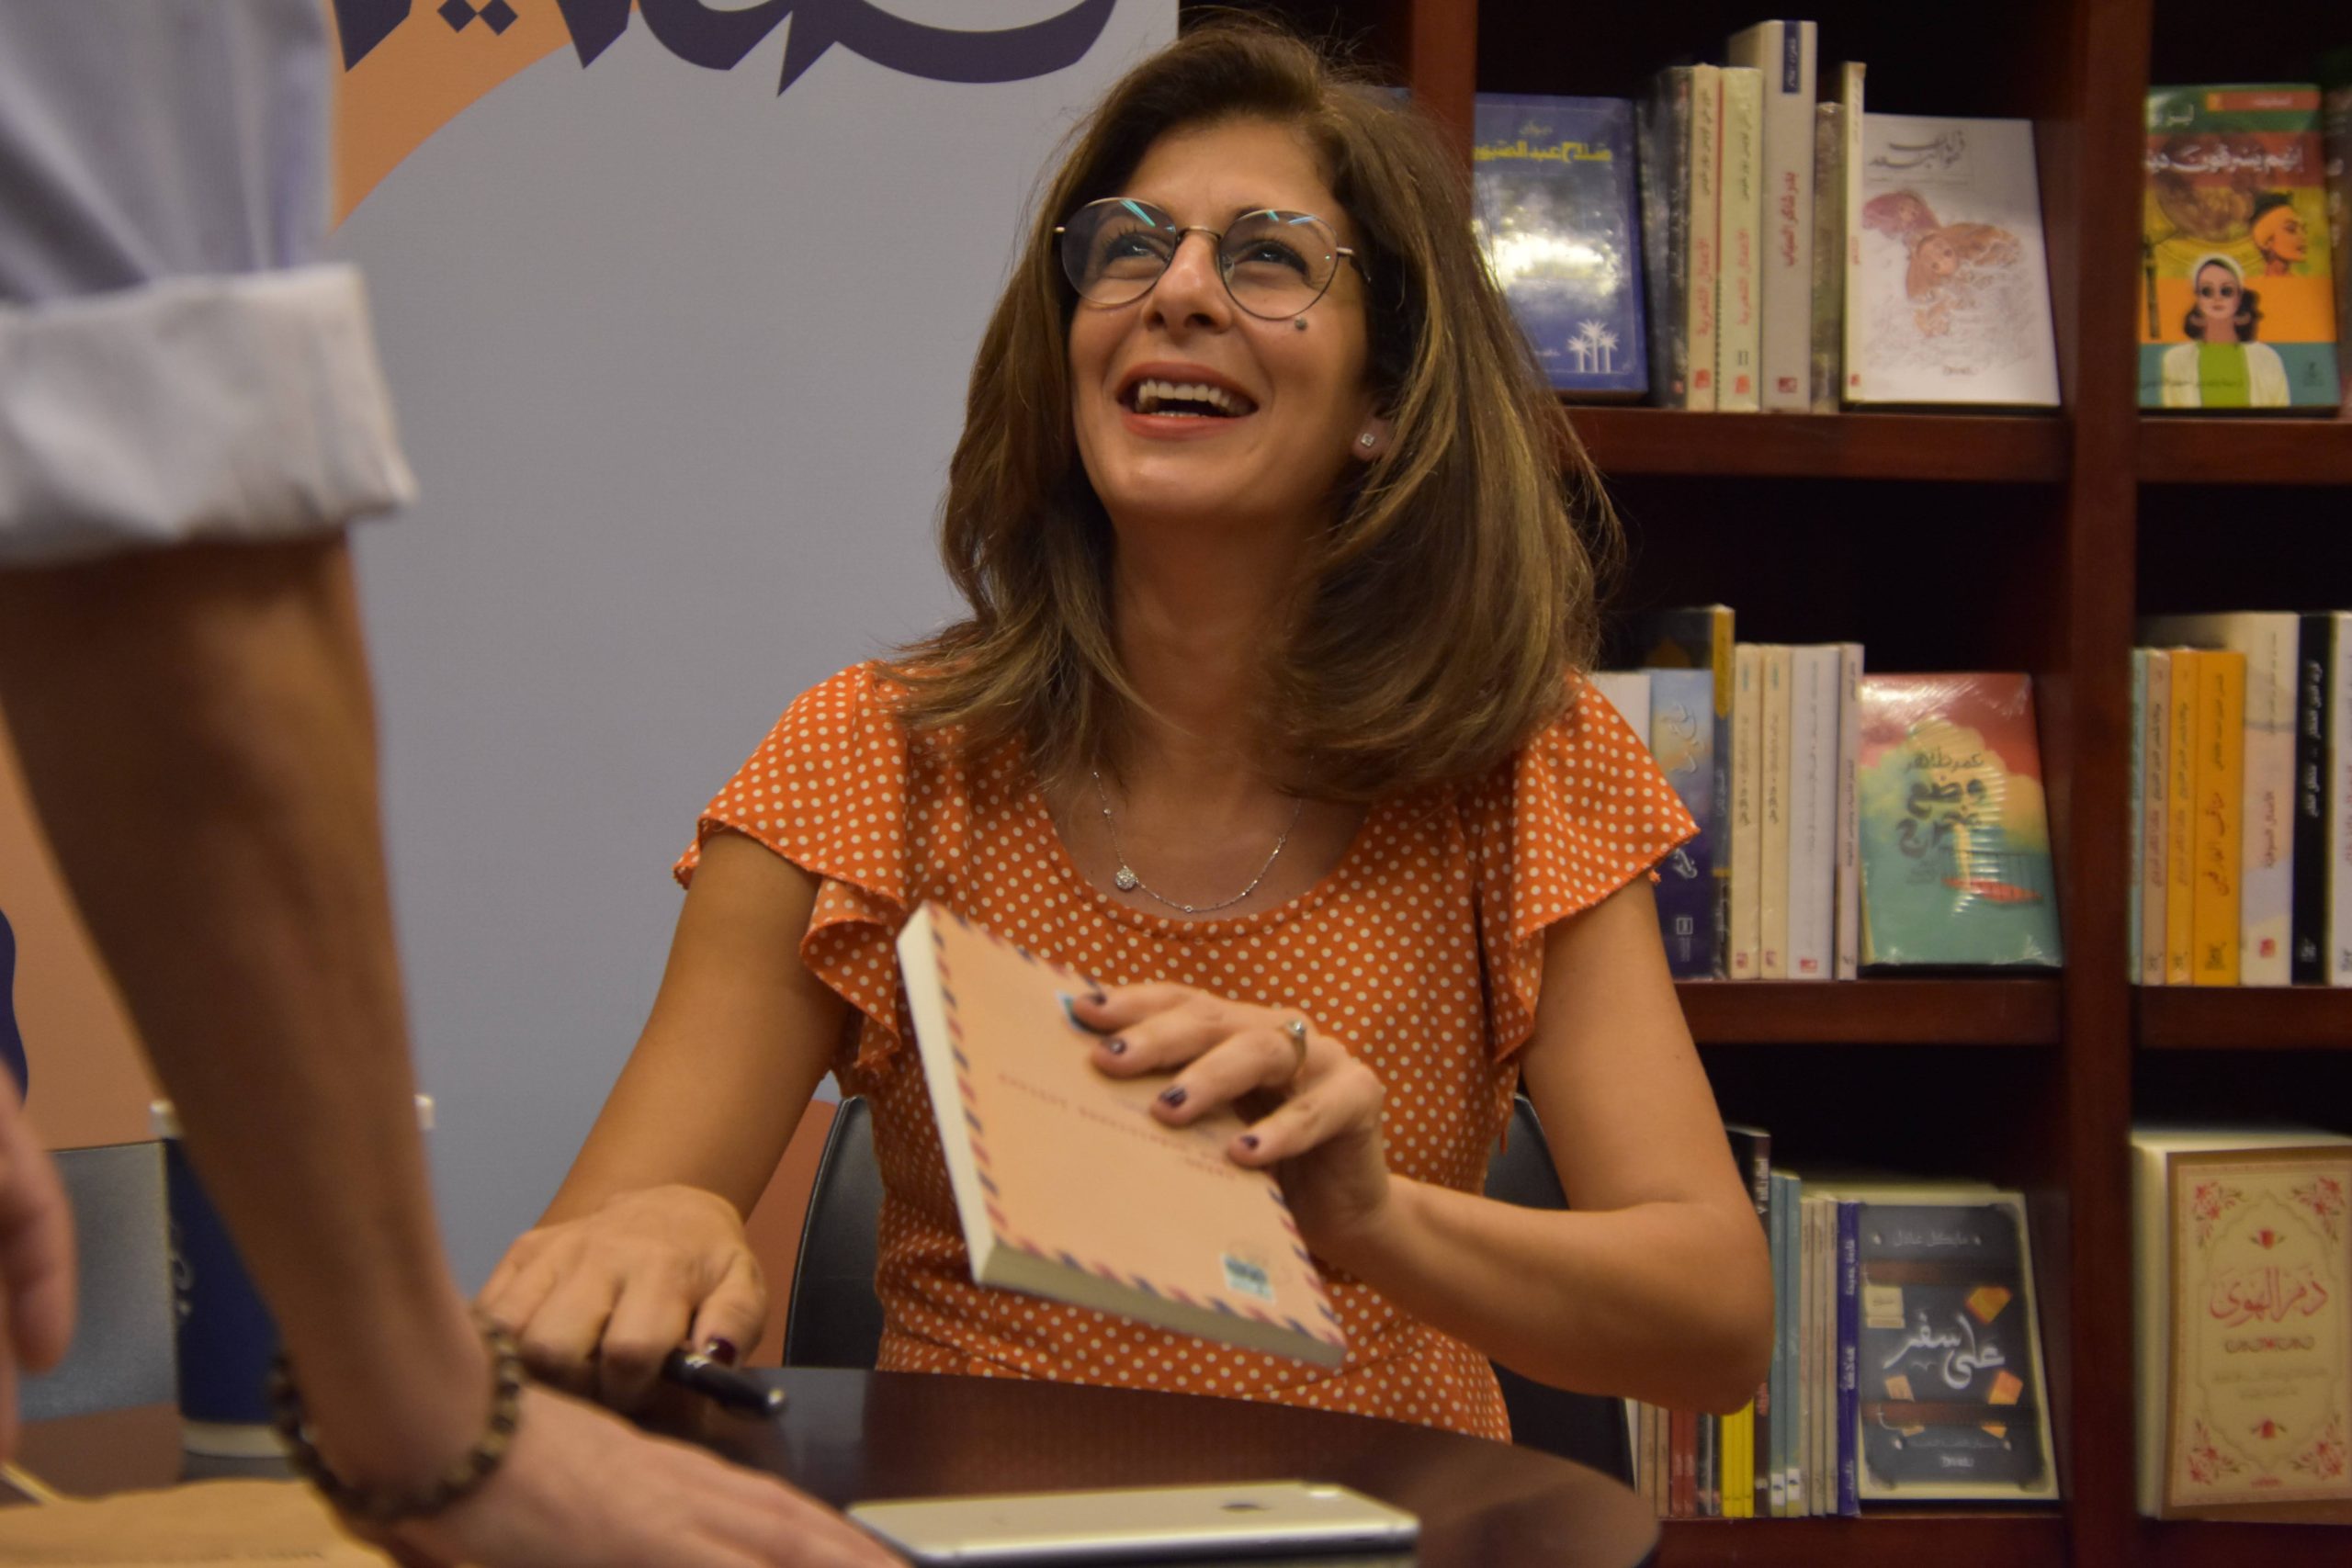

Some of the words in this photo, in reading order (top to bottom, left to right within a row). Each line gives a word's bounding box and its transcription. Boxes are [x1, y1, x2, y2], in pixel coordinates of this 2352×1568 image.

[1529, 144, 1561, 162] عبد
[1561, 141, 1612, 164] صلاح
[1783, 172, 1800, 192] بدر
[1780, 195, 1799, 225] شاكر
[1780, 225, 1799, 267] السياب
[1905, 746, 1952, 773] طاهر
[1951, 752, 1985, 773] عمر
[1893, 1229, 1925, 1248] عادل
[2209, 1266, 2281, 1329] الهوى
[1882, 1311, 1962, 1371] سفر
[1943, 1311, 2006, 1390] على
